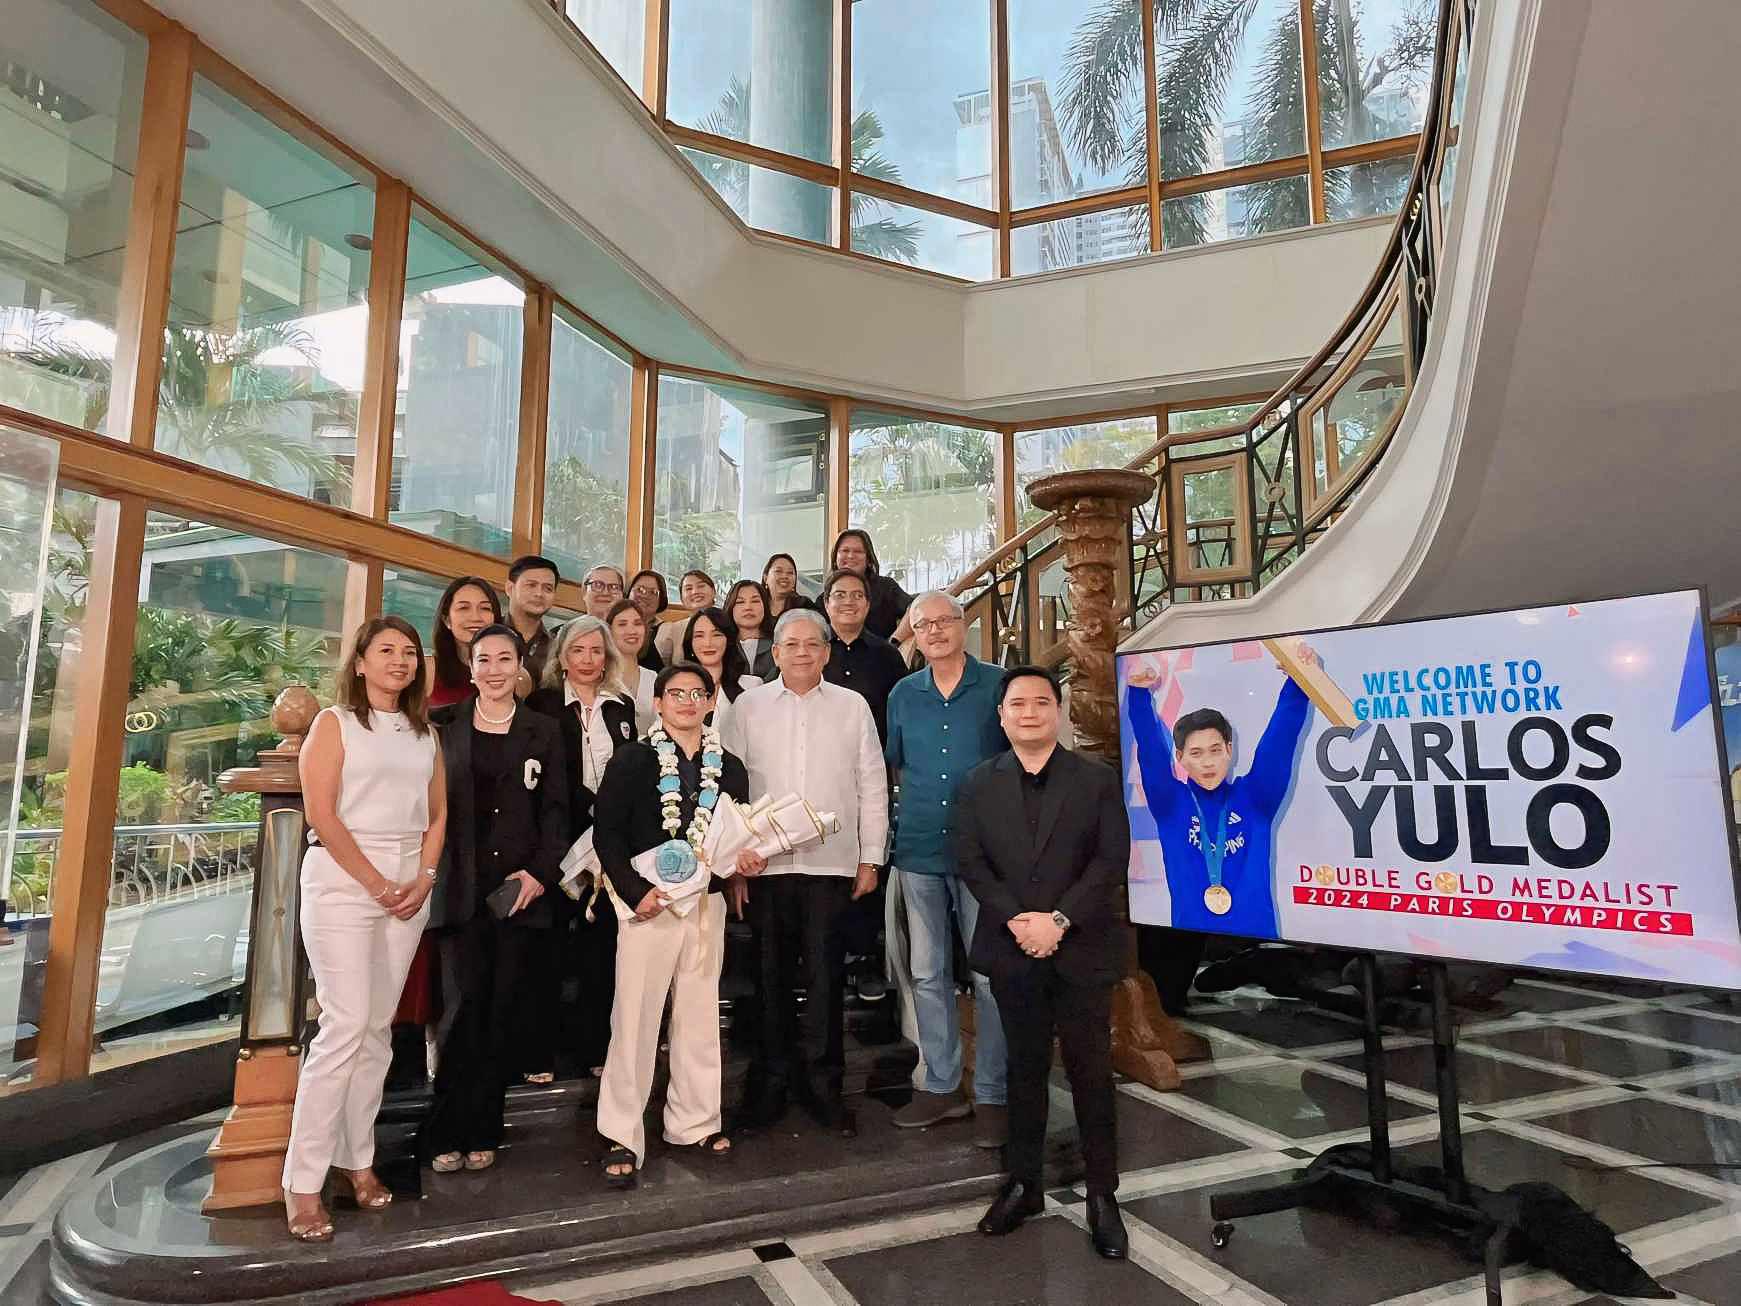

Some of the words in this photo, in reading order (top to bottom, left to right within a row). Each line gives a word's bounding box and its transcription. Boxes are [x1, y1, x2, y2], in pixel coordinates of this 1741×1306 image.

[1362, 663, 1494, 696] WELCOME
[1505, 659, 1542, 685] TO
[1353, 696, 1410, 720] GMA
[1421, 685, 1562, 717] NETWORK
[1316, 713, 1622, 782] CARLOS
[1325, 783, 1611, 869] YULO
[1307, 888, 1369, 908] 2024
[1389, 894, 1473, 916] PARIS
[1496, 902, 1673, 932] OLYMPICS
[1511, 877, 1679, 907] MEDALIST
